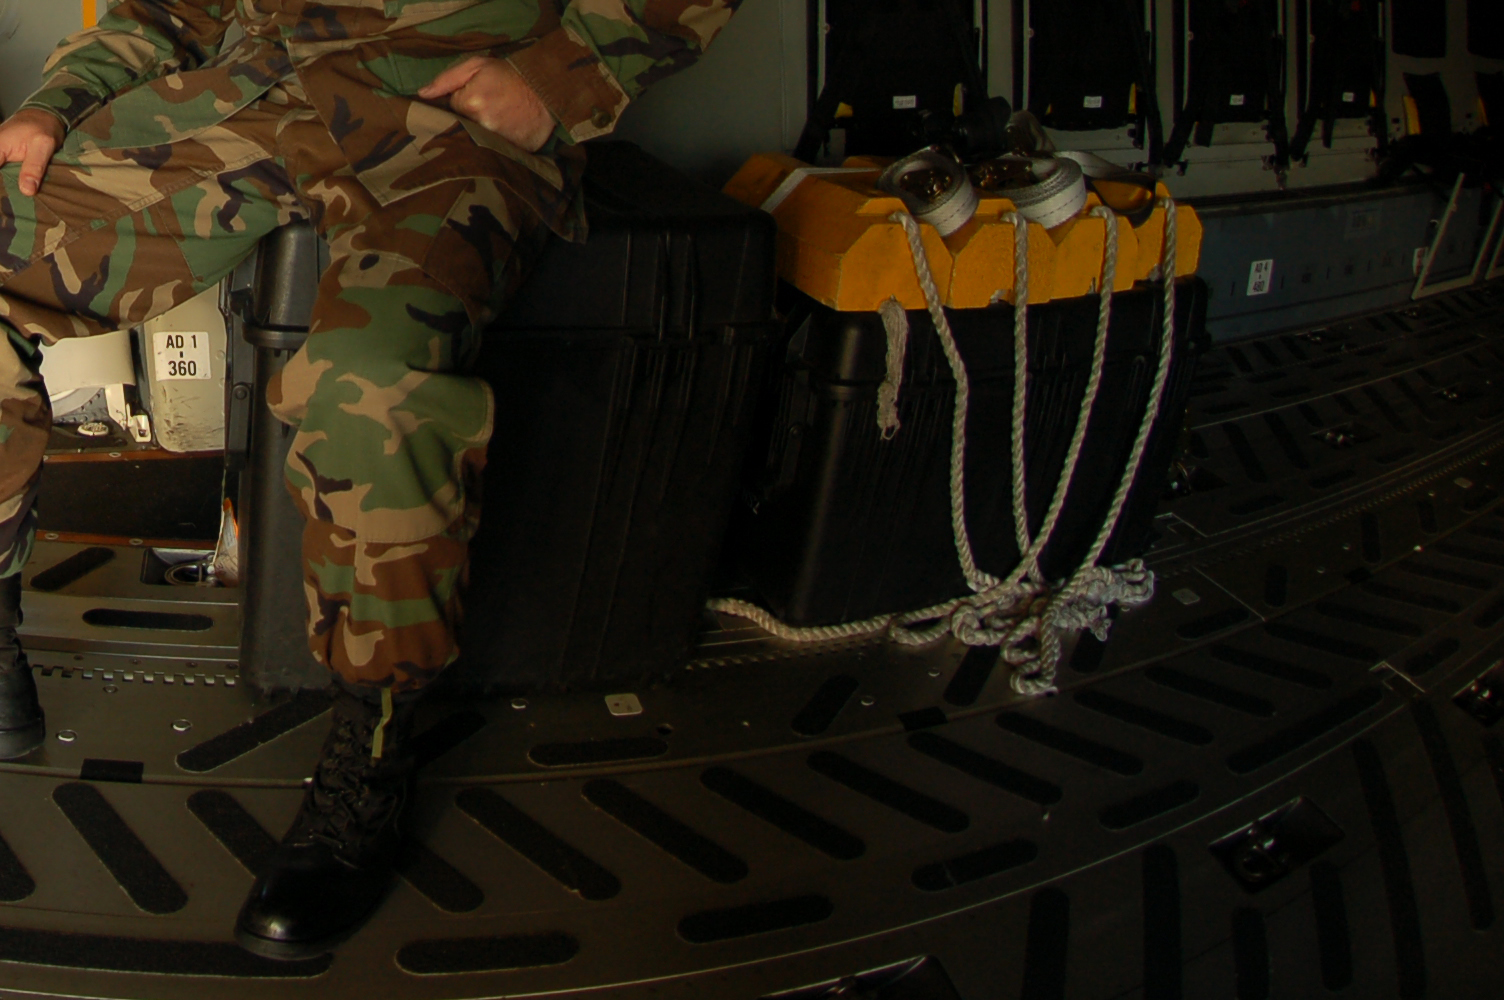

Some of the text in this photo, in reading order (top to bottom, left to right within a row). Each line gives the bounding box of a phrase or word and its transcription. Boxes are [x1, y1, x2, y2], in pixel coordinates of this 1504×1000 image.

[166, 335, 196, 348] AD 1
[169, 361, 196, 376] 360
